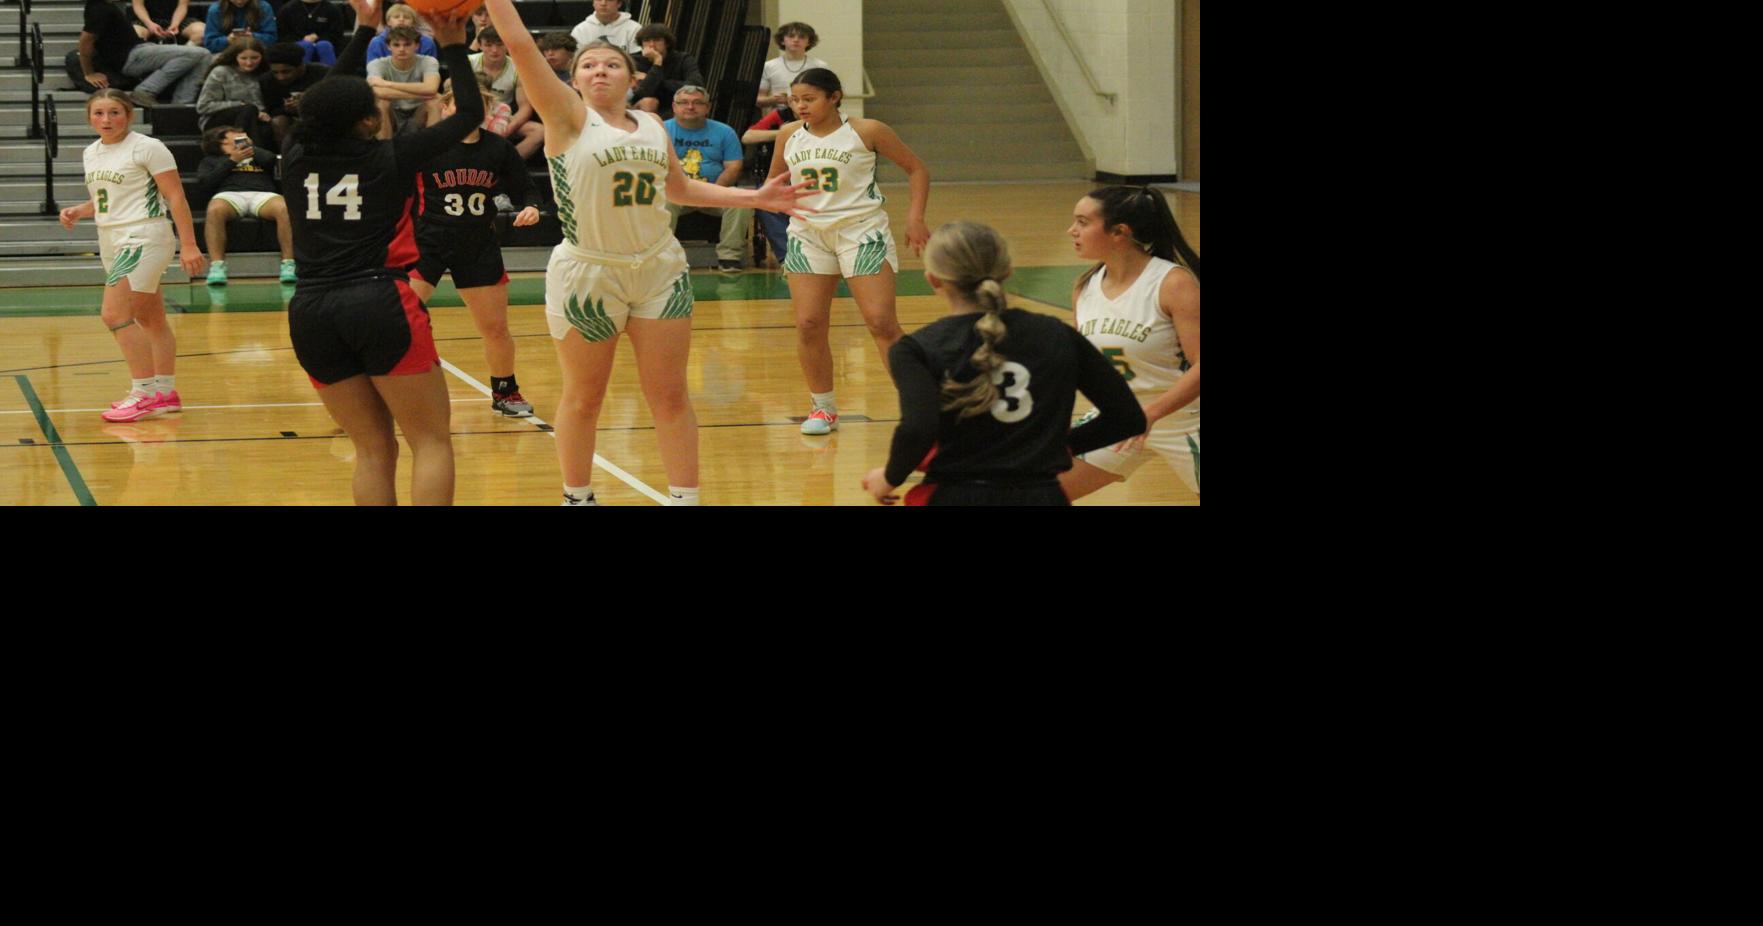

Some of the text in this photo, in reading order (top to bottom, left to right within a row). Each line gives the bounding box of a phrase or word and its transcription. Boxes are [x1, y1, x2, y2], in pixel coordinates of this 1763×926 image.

[593, 146, 667, 169] LADY EAGLE
[790, 148, 852, 166] LADY EAGLES
[612, 171, 657, 207] 20
[801, 167, 838, 192] 33
[97, 188, 108, 213] 2
[304, 173, 363, 220] 14
[444, 192, 486, 216] 30
[1100, 318, 1152, 343] EAGLES
[1101, 347, 1136, 381] 5
[990, 360, 1033, 423] 3
